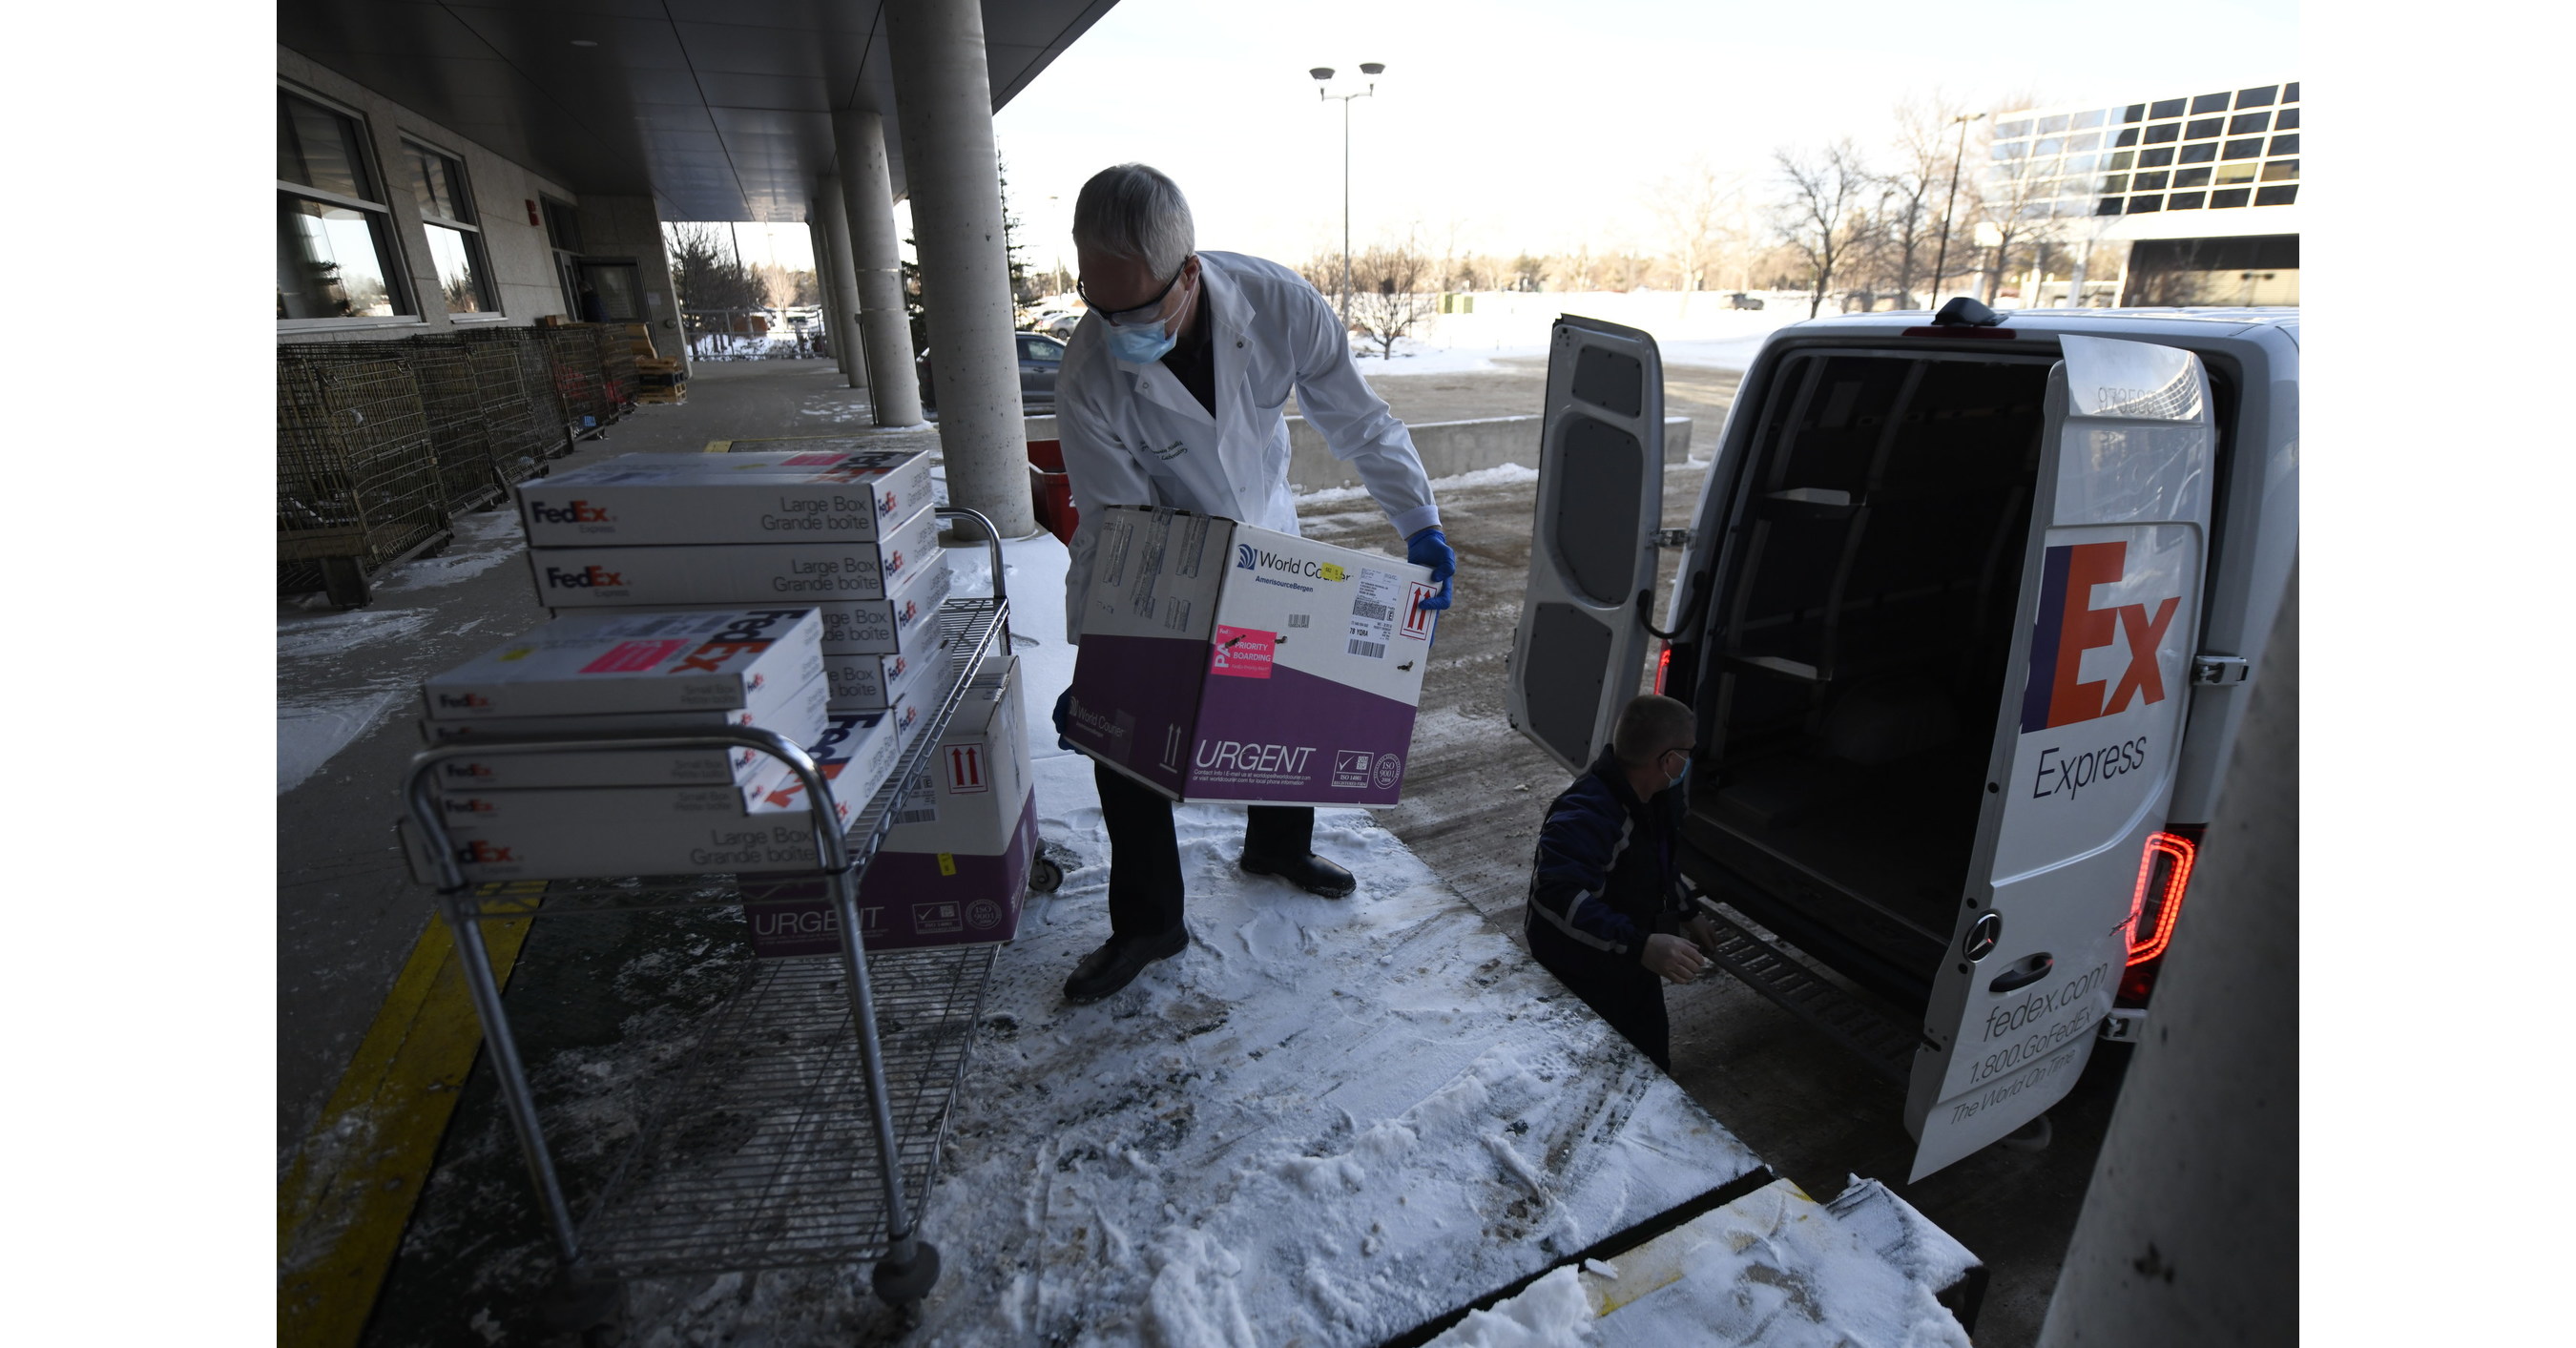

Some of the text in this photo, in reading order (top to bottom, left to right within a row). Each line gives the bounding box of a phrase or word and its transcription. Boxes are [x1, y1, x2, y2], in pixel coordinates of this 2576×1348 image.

[530, 500, 610, 523] FedEx
[779, 495, 868, 516] Large Box
[579, 524, 616, 534] Express
[762, 514, 870, 530] Grande boîte
[546, 565, 624, 588] FedEx
[792, 557, 878, 577] Large Box
[1259, 550, 1301, 574] World
[1303, 561, 1351, 582] Coer
[773, 575, 880, 592] Grande boîte
[1255, 574, 1314, 593] AmerisourceBergen
[823, 609, 888, 628] rge Box
[668, 609, 811, 674] FedEx
[849, 626, 890, 641] boîte
[1233, 651, 1272, 662] BOARDING
[1234, 641, 1269, 652] PRIORITY
[843, 667, 875, 681] Box
[839, 683, 877, 696] boîte
[439, 693, 488, 708] FedEx
[1077, 704, 1125, 737] World Courier
[1195, 739, 1317, 773] URGENT
[1382, 760, 1396, 770] ISO
[1379, 769, 1396, 778] 9001
[2033, 736, 2147, 800] Express
[711, 826, 812, 848] Large Box
[458, 840, 514, 864] dEx
[690, 844, 818, 866] Grande boîte
[755, 905, 885, 936] URGET
[1983, 963, 2109, 1043] fedex.com
[1970, 1006, 2093, 1085] 1.800.GoFedEx
[1950, 1049, 2076, 1126] The World On Time
